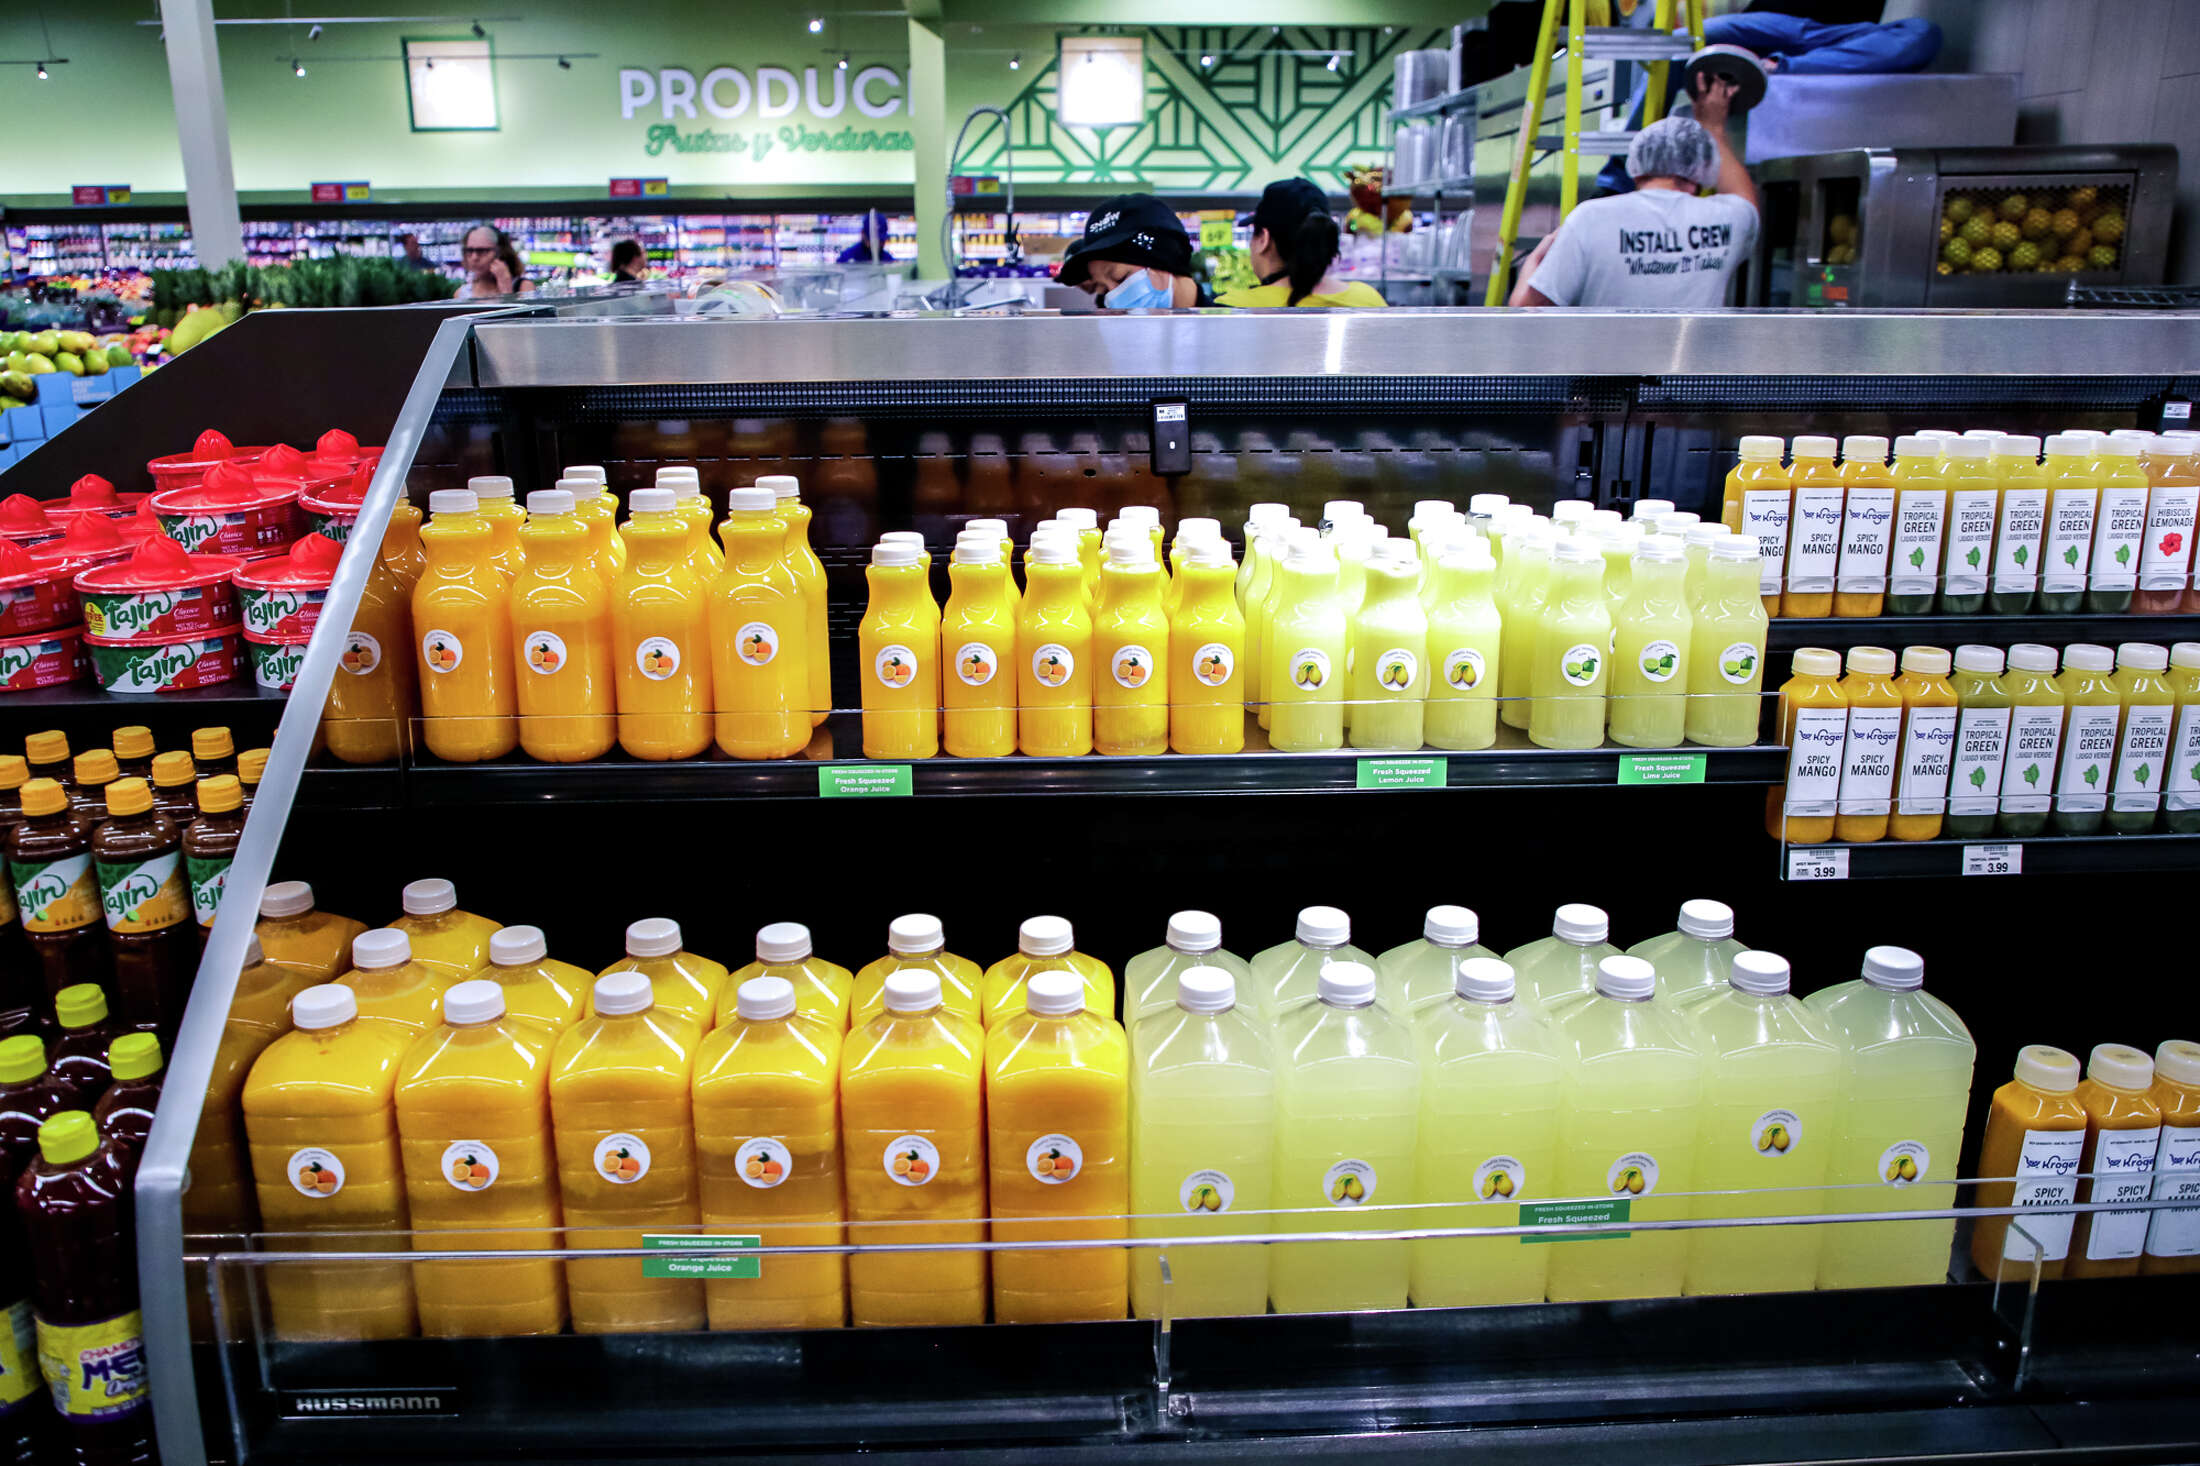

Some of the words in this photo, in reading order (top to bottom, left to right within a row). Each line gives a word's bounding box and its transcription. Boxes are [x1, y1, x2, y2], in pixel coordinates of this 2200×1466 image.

[619, 66, 915, 119] PRODUC
[645, 123, 748, 157] Frutas
[748, 131, 773, 162] y
[1862, 507, 1890, 525] Kroger
[1903, 511, 1938, 521] TROPICAL
[1961, 511, 1993, 520] TROPICAL
[2010, 510, 2043, 519] TROPICAL
[2059, 510, 2092, 519] TROPICAL
[2158, 508, 2191, 517] HIBISCUS
[1903, 521, 1936, 533] GREEN
[1961, 521, 1991, 533] GREEN
[2009, 520, 2040, 531] GREEN
[2059, 520, 2090, 531] GREEN
[2111, 519, 2142, 530] GREEN
[2150, 517, 2194, 528] LEMONADE
[1810, 533, 1833, 543] SPICY
[1856, 533, 1879, 543] SPICY
[1759, 545, 1784, 557] ANGO
[1847, 543, 1883, 555] MANGO
[1866, 728, 1897, 745] Kroger
[1965, 730, 2002, 739] TROPICAL
[2019, 727, 2056, 737] TROPICAL
[2080, 728, 2115, 738] TROPICAL
[2131, 727, 2167, 736] TROPICAL
[1813, 729, 1844, 746] Kroger
[1965, 741, 1999, 752] GREEN
[2019, 738, 2053, 749] GREEN
[2079, 739, 2112, 750] GREEN
[2130, 738, 2164, 749] GREEN
[1807, 755, 1831, 764] SPICY
[1860, 754, 1885, 764] SPICY
[1921, 754, 1945, 764] SPICY
[1797, 765, 1837, 777] MANGO
[1851, 765, 1890, 776] MANGO
[835, 777, 857, 785] Fresh
[858, 776, 896, 784] Squeezed
[1814, 867, 1836, 878] 3.99
[1987, 863, 2009, 873] 3.99
[2042, 1155, 2079, 1175] Kroger
[2034, 1187, 2065, 1197] SPICY
[2117, 1185, 2146, 1196] SPICY
[2179, 1182, 2200, 1194] SPIC
[1538, 1216, 1564, 1224] Fresh
[1565, 1213, 1611, 1223] Squeezed
[668, 1263, 705, 1272] Orange
[706, 1263, 732, 1272] Juice
